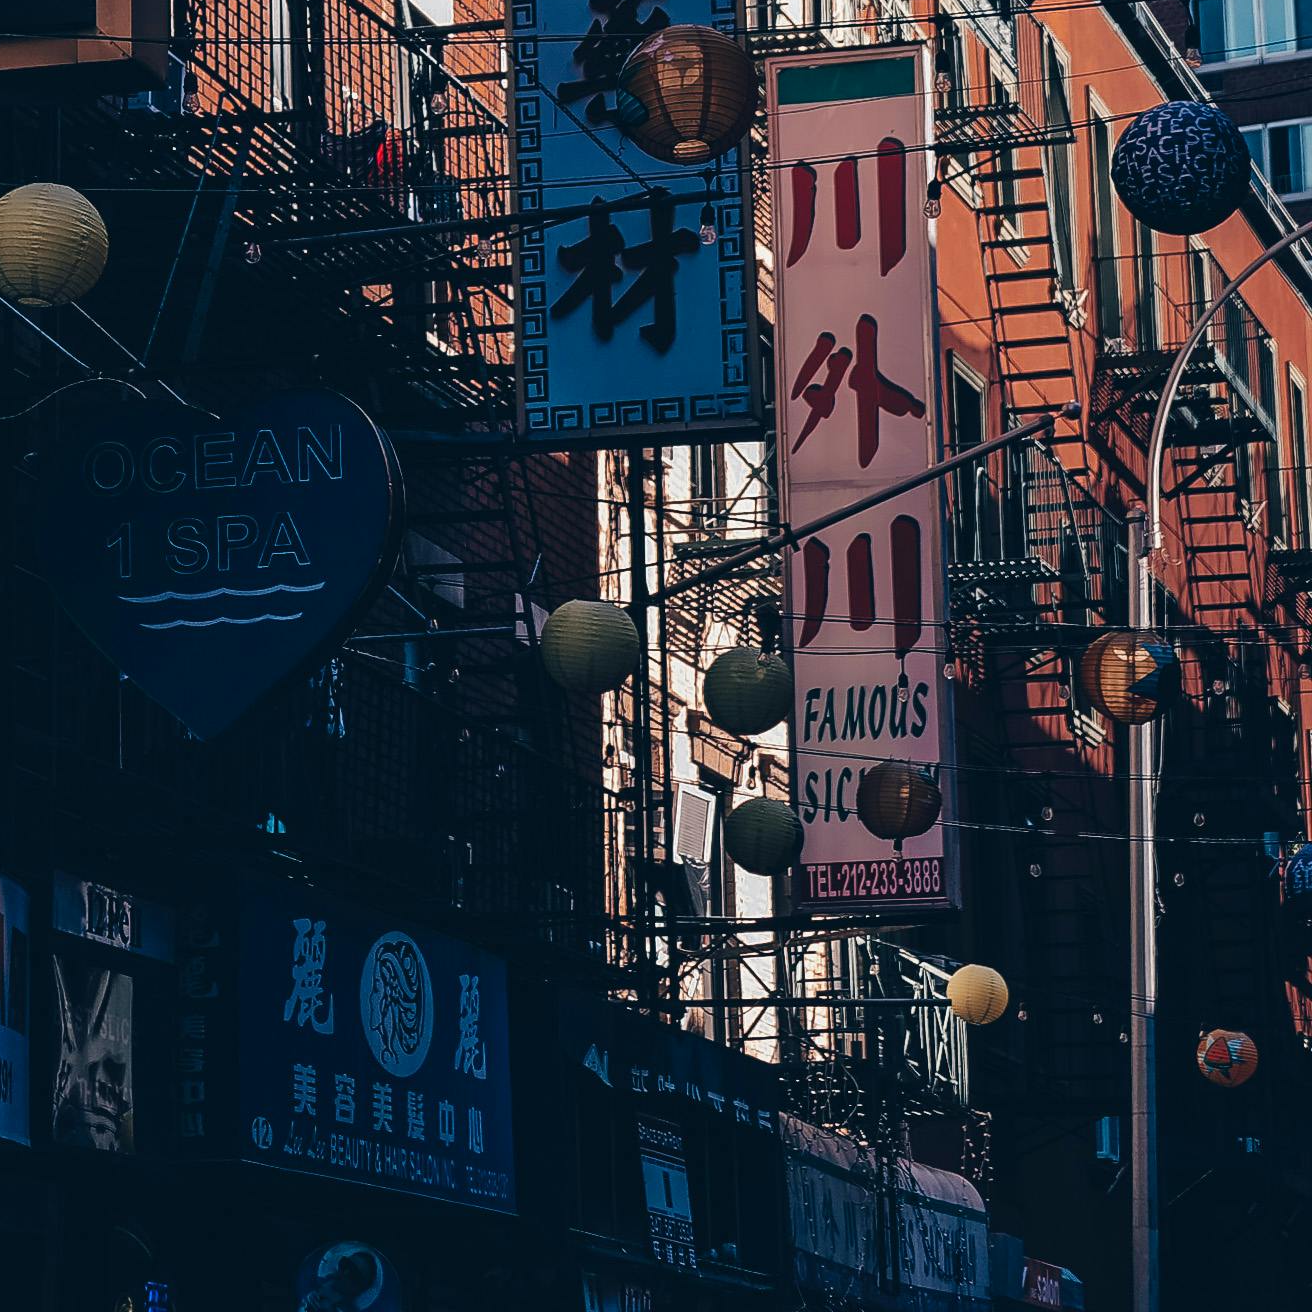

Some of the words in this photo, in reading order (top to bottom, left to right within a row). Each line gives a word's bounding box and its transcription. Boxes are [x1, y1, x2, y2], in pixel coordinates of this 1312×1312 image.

[787, 135, 927, 655] 川外川
[85, 423, 344, 497] OCEAN
[105, 521, 137, 579] 1
[166, 511, 311, 575] SPA
[803, 681, 930, 744] FAMOUS
[330, 1132, 372, 1173] BEAUTY
[375, 1143, 382, 1174] &
